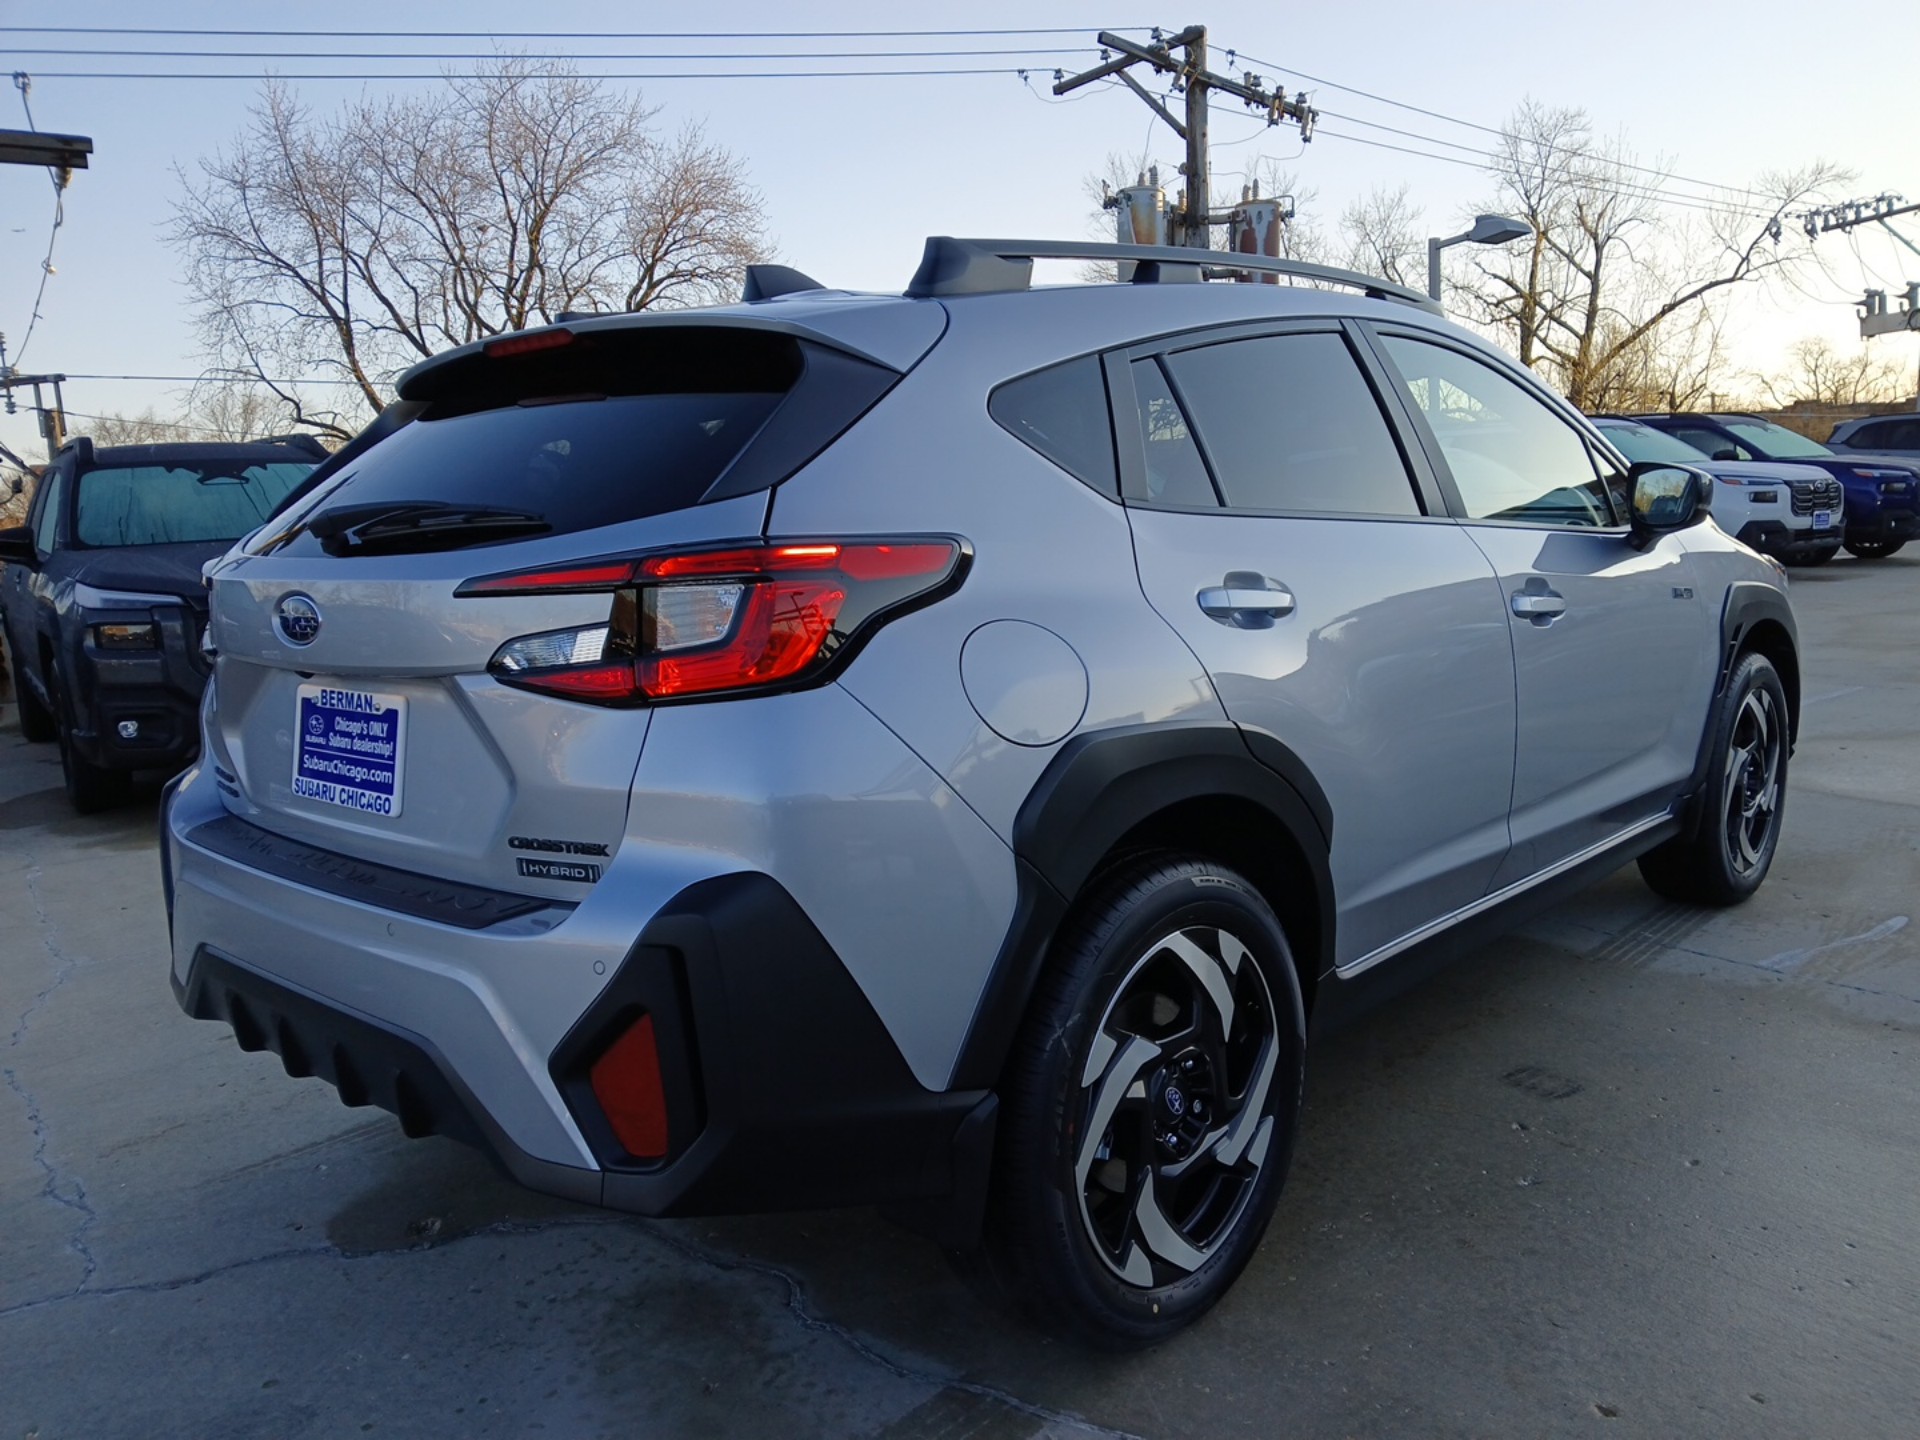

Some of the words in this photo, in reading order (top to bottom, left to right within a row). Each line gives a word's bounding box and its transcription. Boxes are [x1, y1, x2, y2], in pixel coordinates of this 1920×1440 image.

[321, 689, 373, 712] BERMAN
[335, 716, 368, 736] Chicago's
[369, 721, 388, 737] ONLY
[305, 735, 326, 745] SUBARU
[328, 732, 352, 750] Subaru
[352, 737, 394, 758] dealership!
[303, 754, 392, 784] SubaruChicago.com
[294, 778, 336, 802] SUBARU
[339, 788, 392, 814] CHICAGO
[508, 836, 610, 857] CROSSTREK
[529, 864, 586, 878] HYBRID
